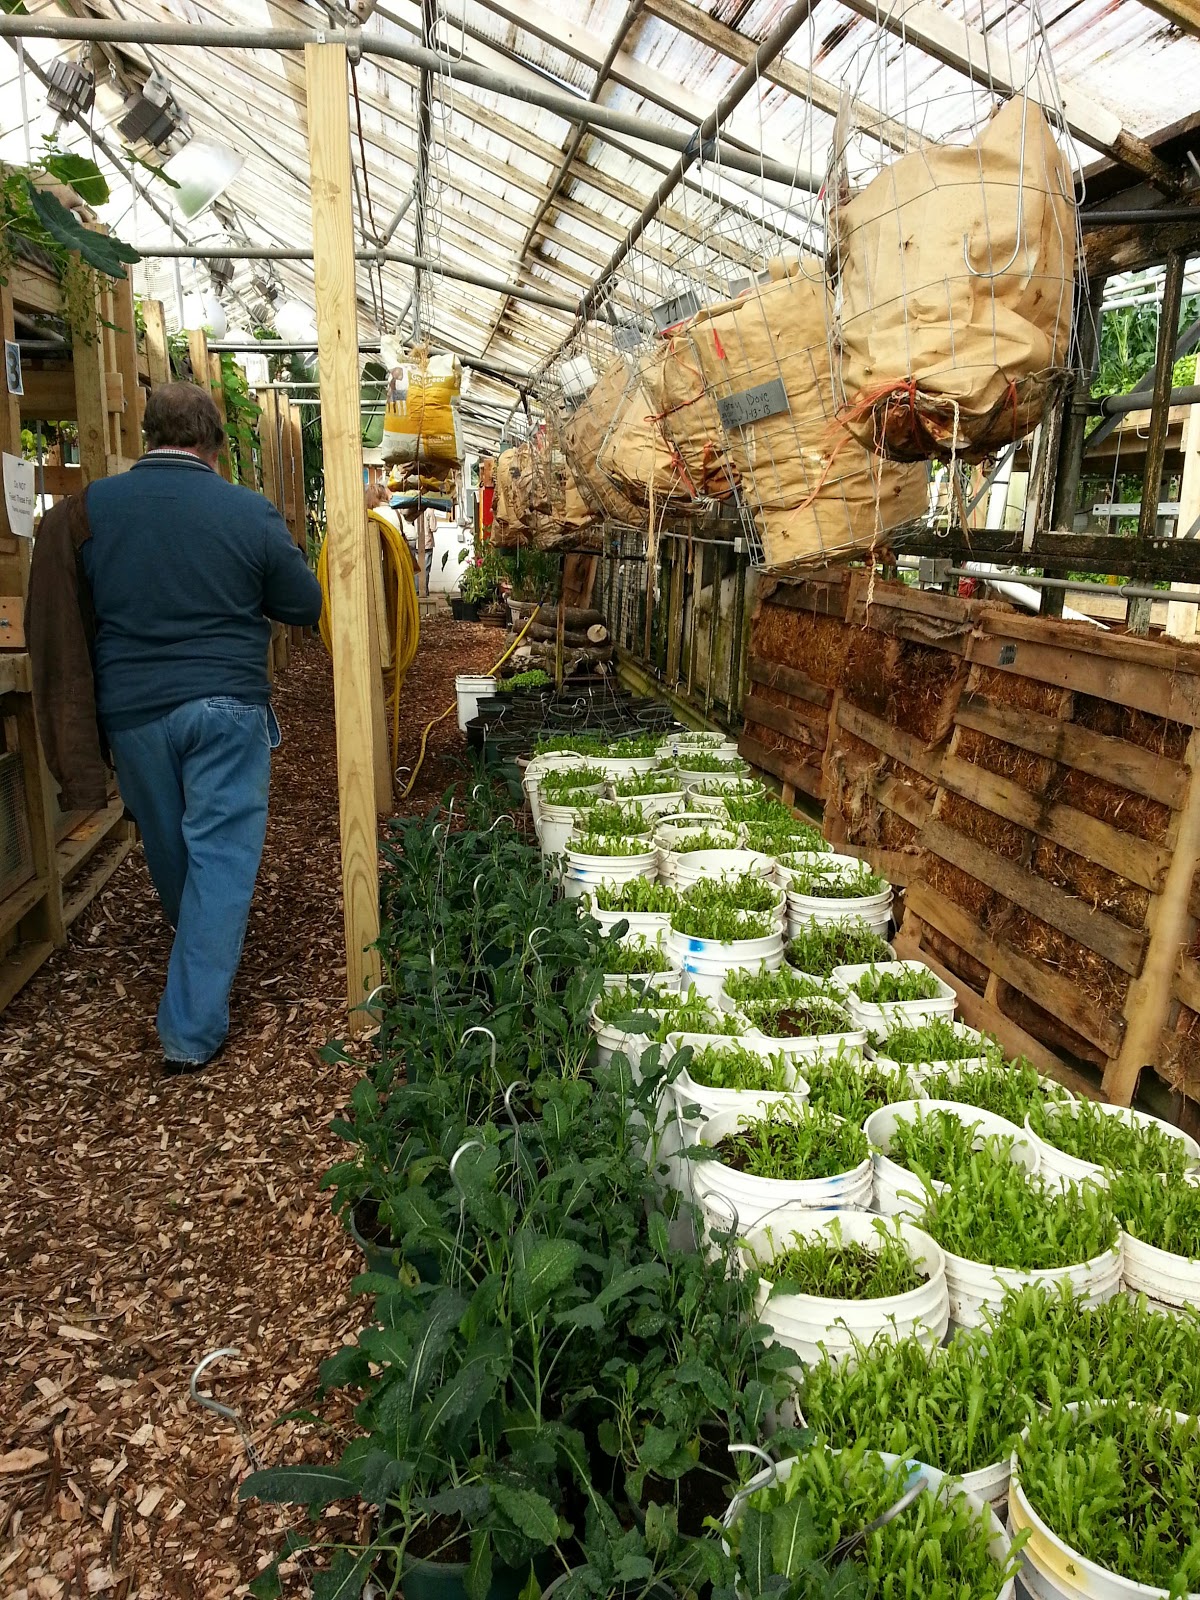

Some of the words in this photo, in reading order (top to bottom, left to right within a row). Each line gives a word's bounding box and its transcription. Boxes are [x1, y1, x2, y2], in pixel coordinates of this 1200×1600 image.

[664, 300, 679, 325] 11
[411, 373, 427, 385] Got
[746, 392, 770, 406] Dove
